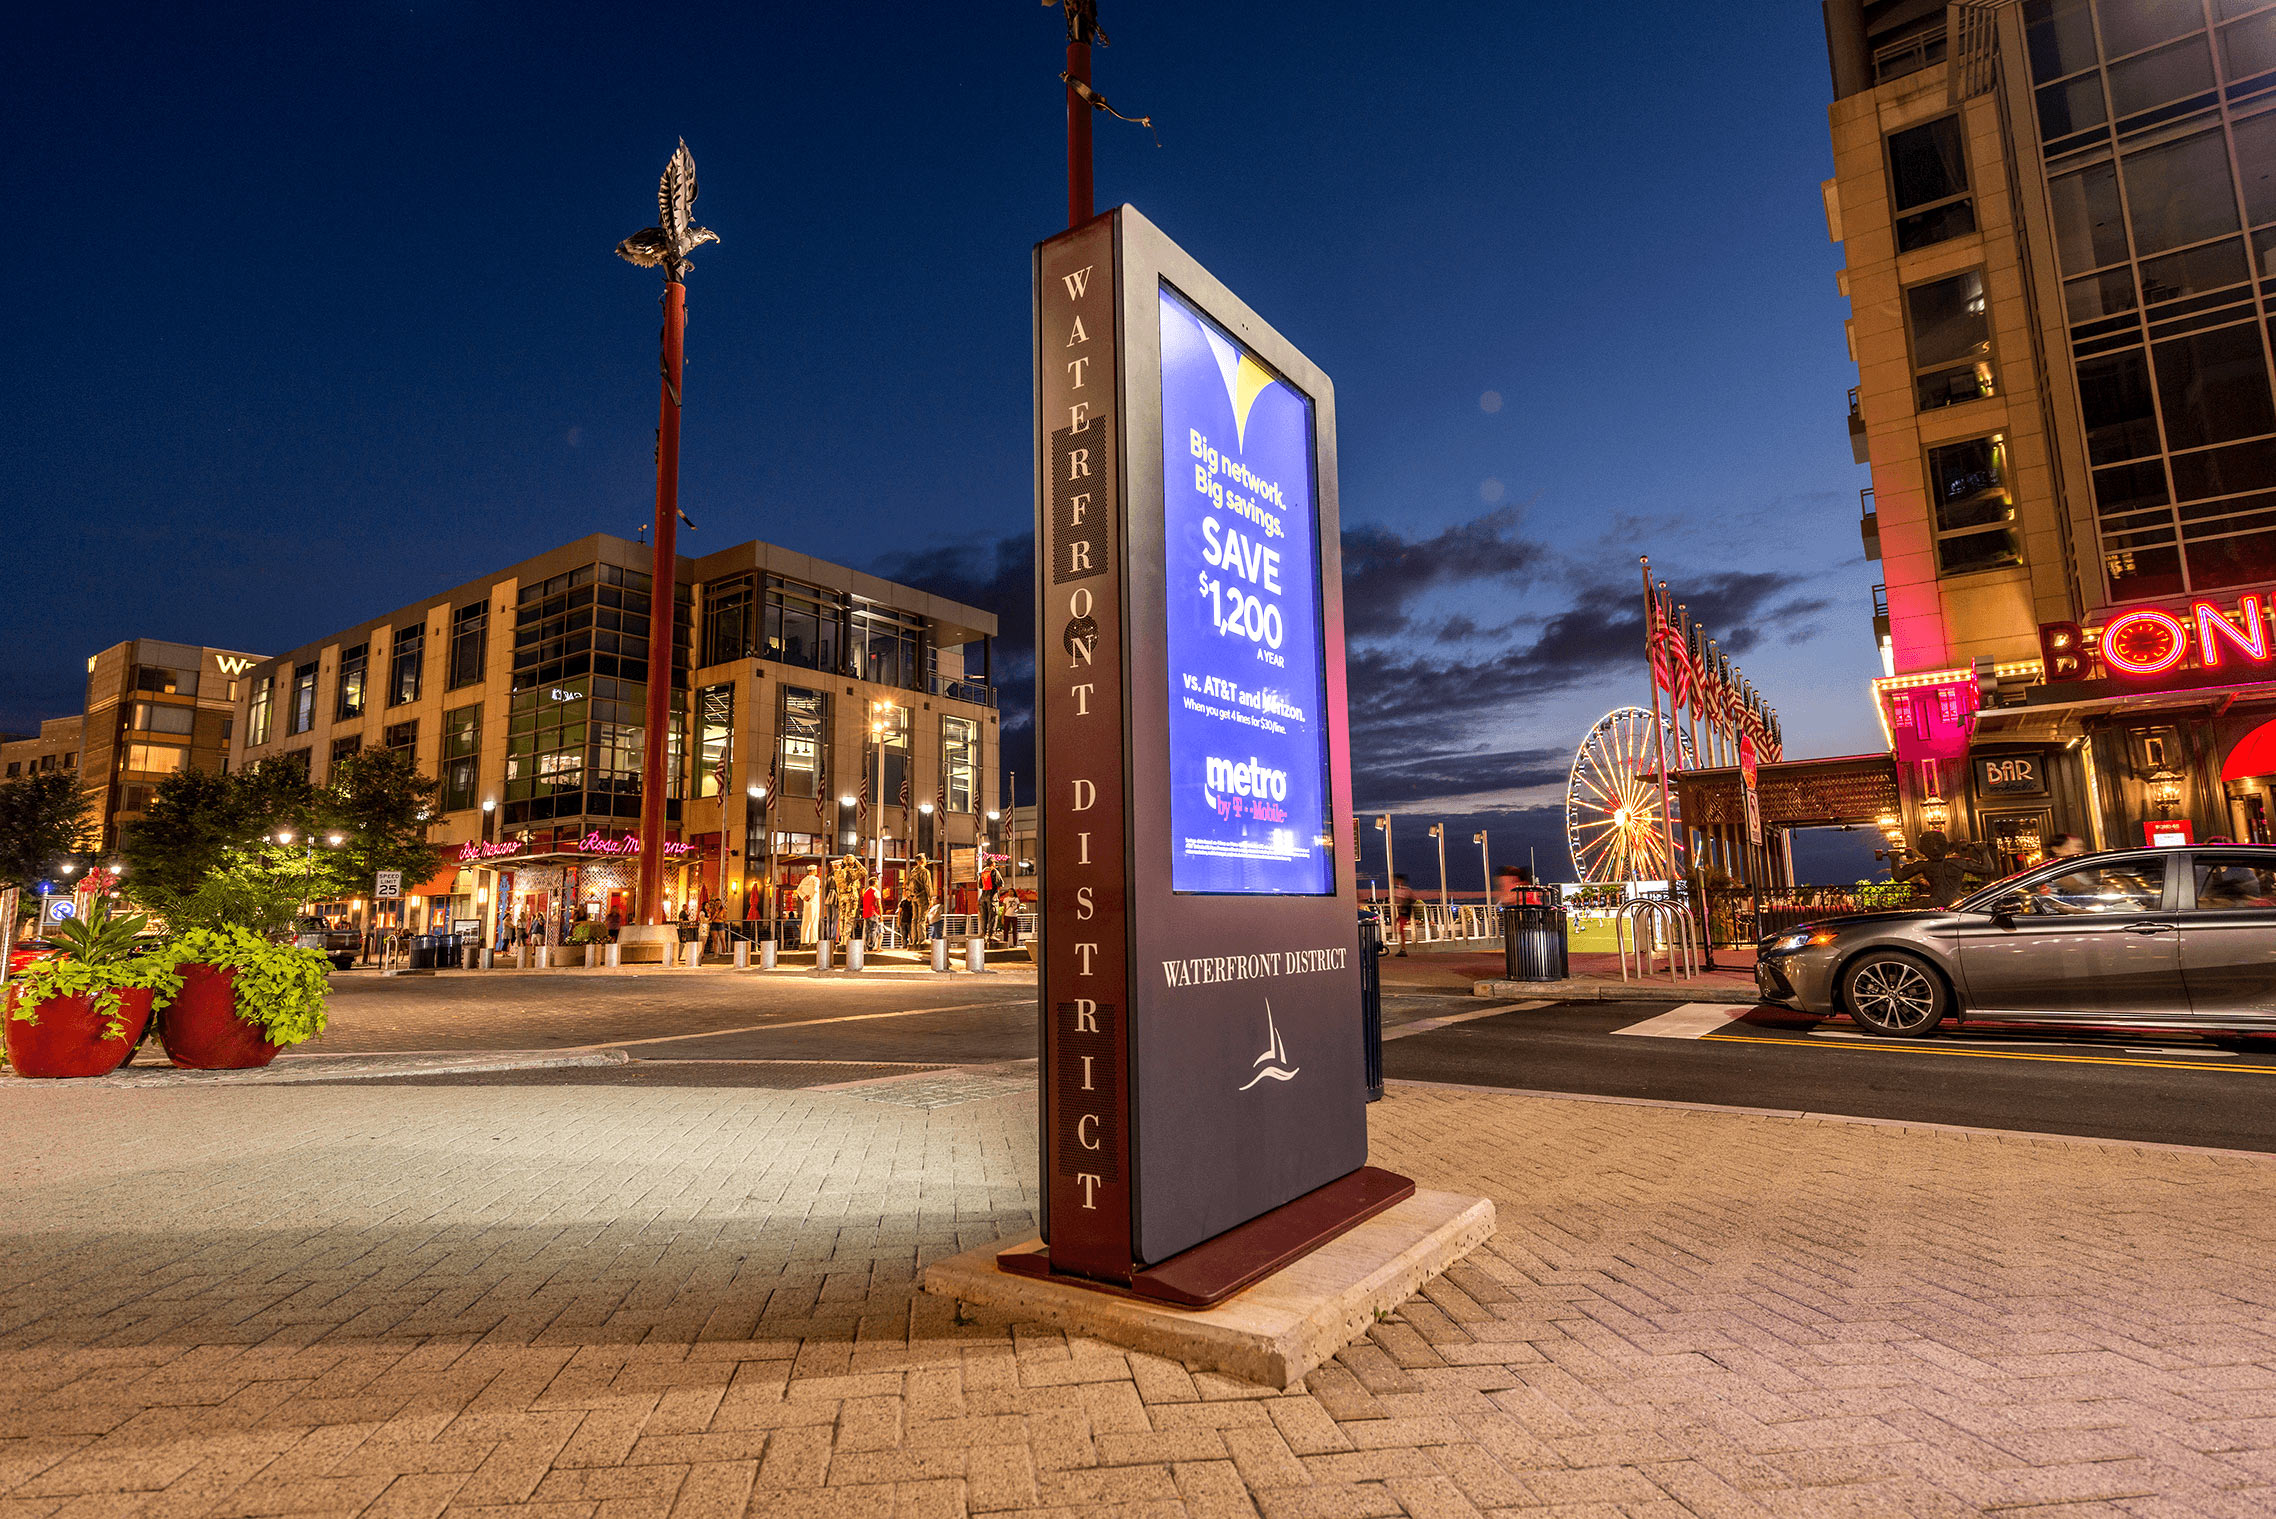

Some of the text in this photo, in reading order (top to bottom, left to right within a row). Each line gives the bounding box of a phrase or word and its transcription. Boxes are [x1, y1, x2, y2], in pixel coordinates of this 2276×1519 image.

[1190, 427, 1287, 511] Big network.
[1195, 463, 1285, 538] Big savings.
[1202, 515, 1282, 595] SAVE
[1199, 570, 1283, 650] $1,200
[1257, 648, 1285, 668] A YEAR
[1204, 675, 1237, 702] AT&T
[1239, 690, 1261, 709] and
[1183, 696, 1206, 713] When
[1206, 705, 1219, 717] you
[1219, 709, 1231, 720] get
[1231, 710, 1236, 721] 4
[1236, 711, 1251, 725] lines
[1251, 715, 1260, 727] for
[1062, 265, 1101, 1210] WATERFRONT DISTRICT
[1205, 756, 1287, 802] metro
[1986, 760, 2034, 784] BAR
[1217, 794, 1231, 822] by
[459, 839, 522, 860] Rosa Mexicano
[579, 830, 621, 853] Rosa
[378, 884, 398, 895] 25
[1162, 947, 1347, 989] WATERFRONT DISTRICT
